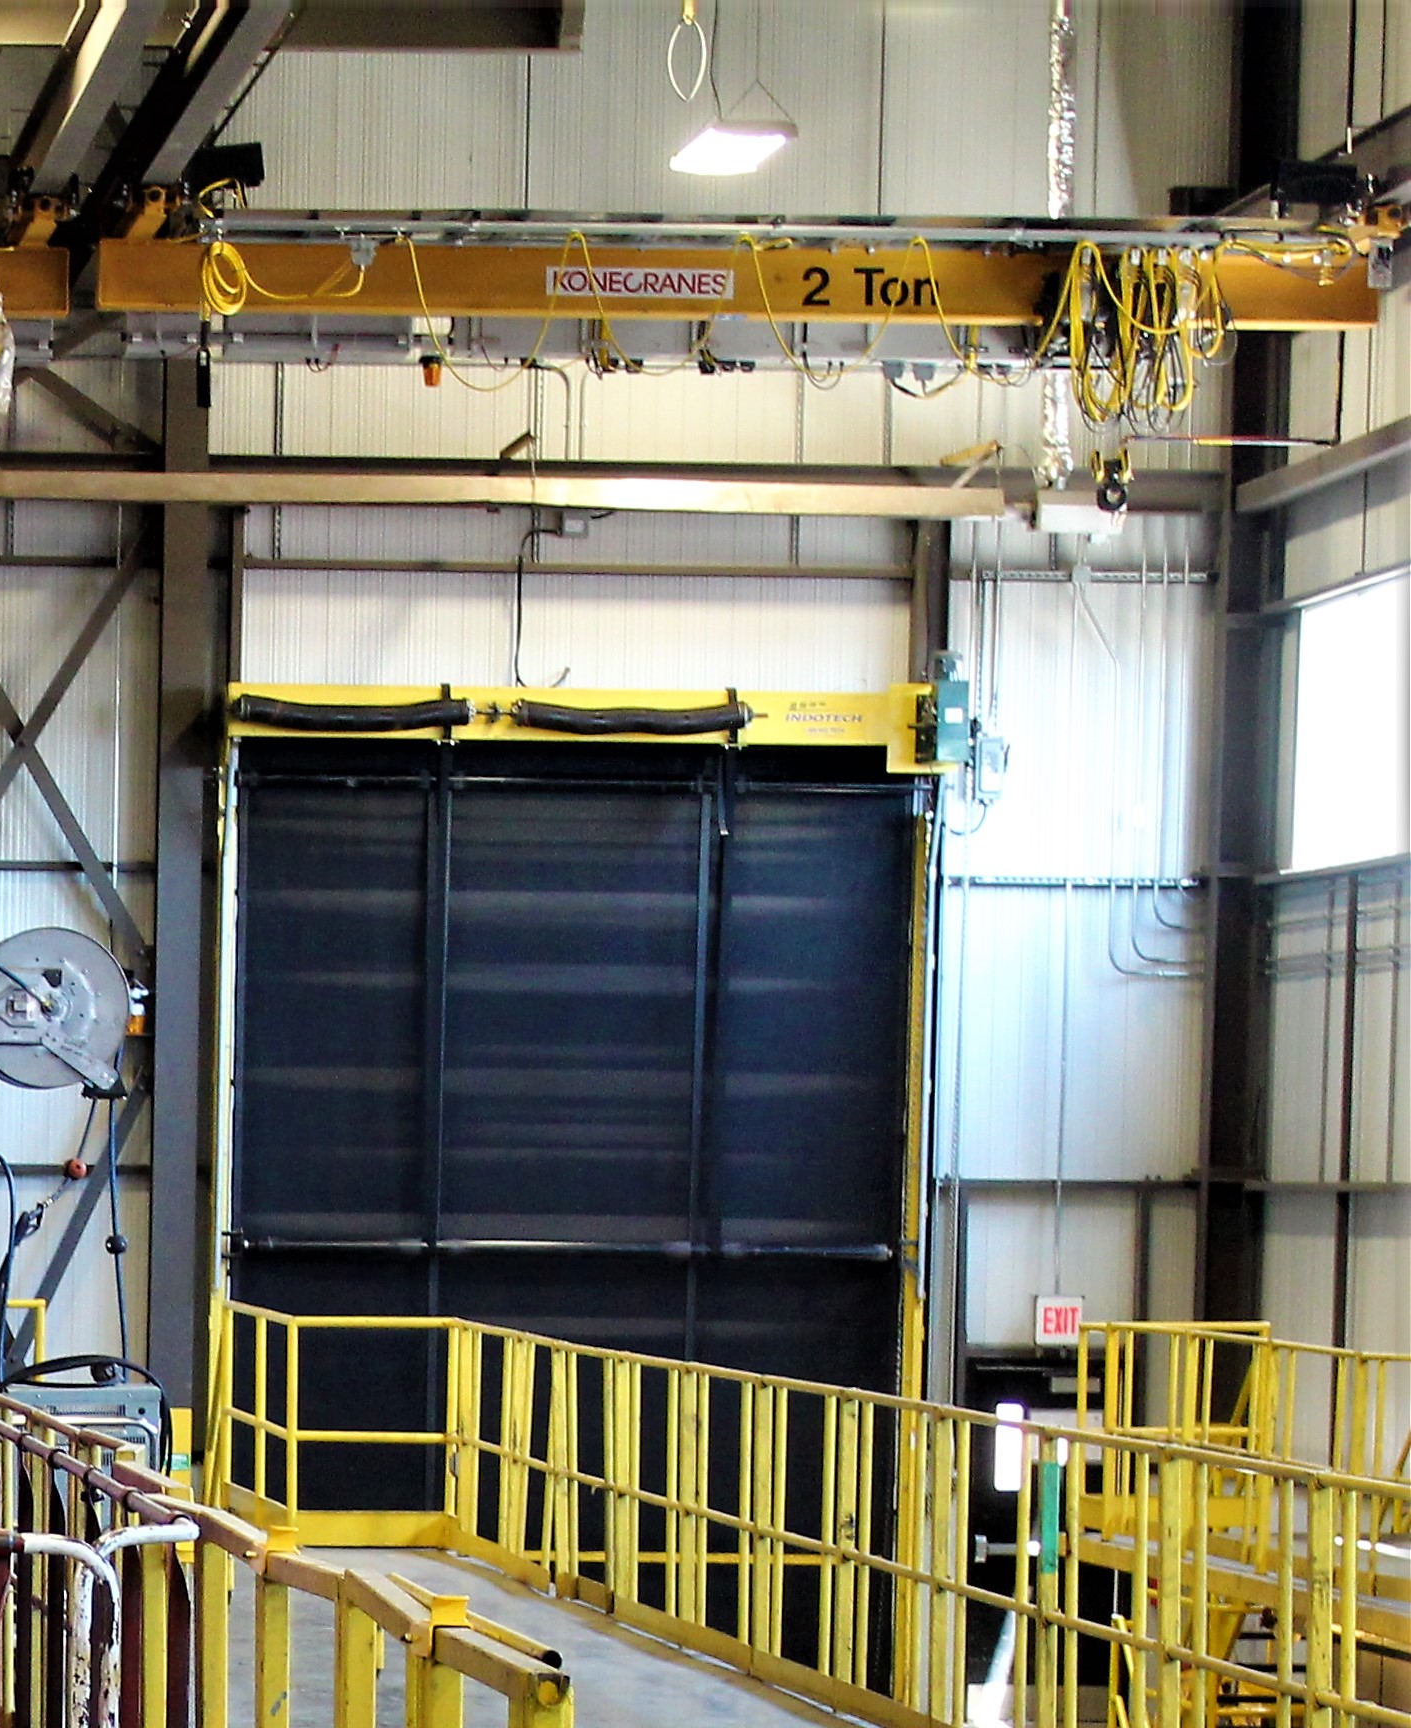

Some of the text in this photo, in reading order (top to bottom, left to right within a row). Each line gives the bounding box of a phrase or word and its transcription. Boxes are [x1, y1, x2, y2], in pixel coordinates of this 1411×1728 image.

[552, 270, 727, 295] KONECRANES
[801, 267, 940, 307] 2 Ton
[1043, 1307, 1079, 1334] EXIT
